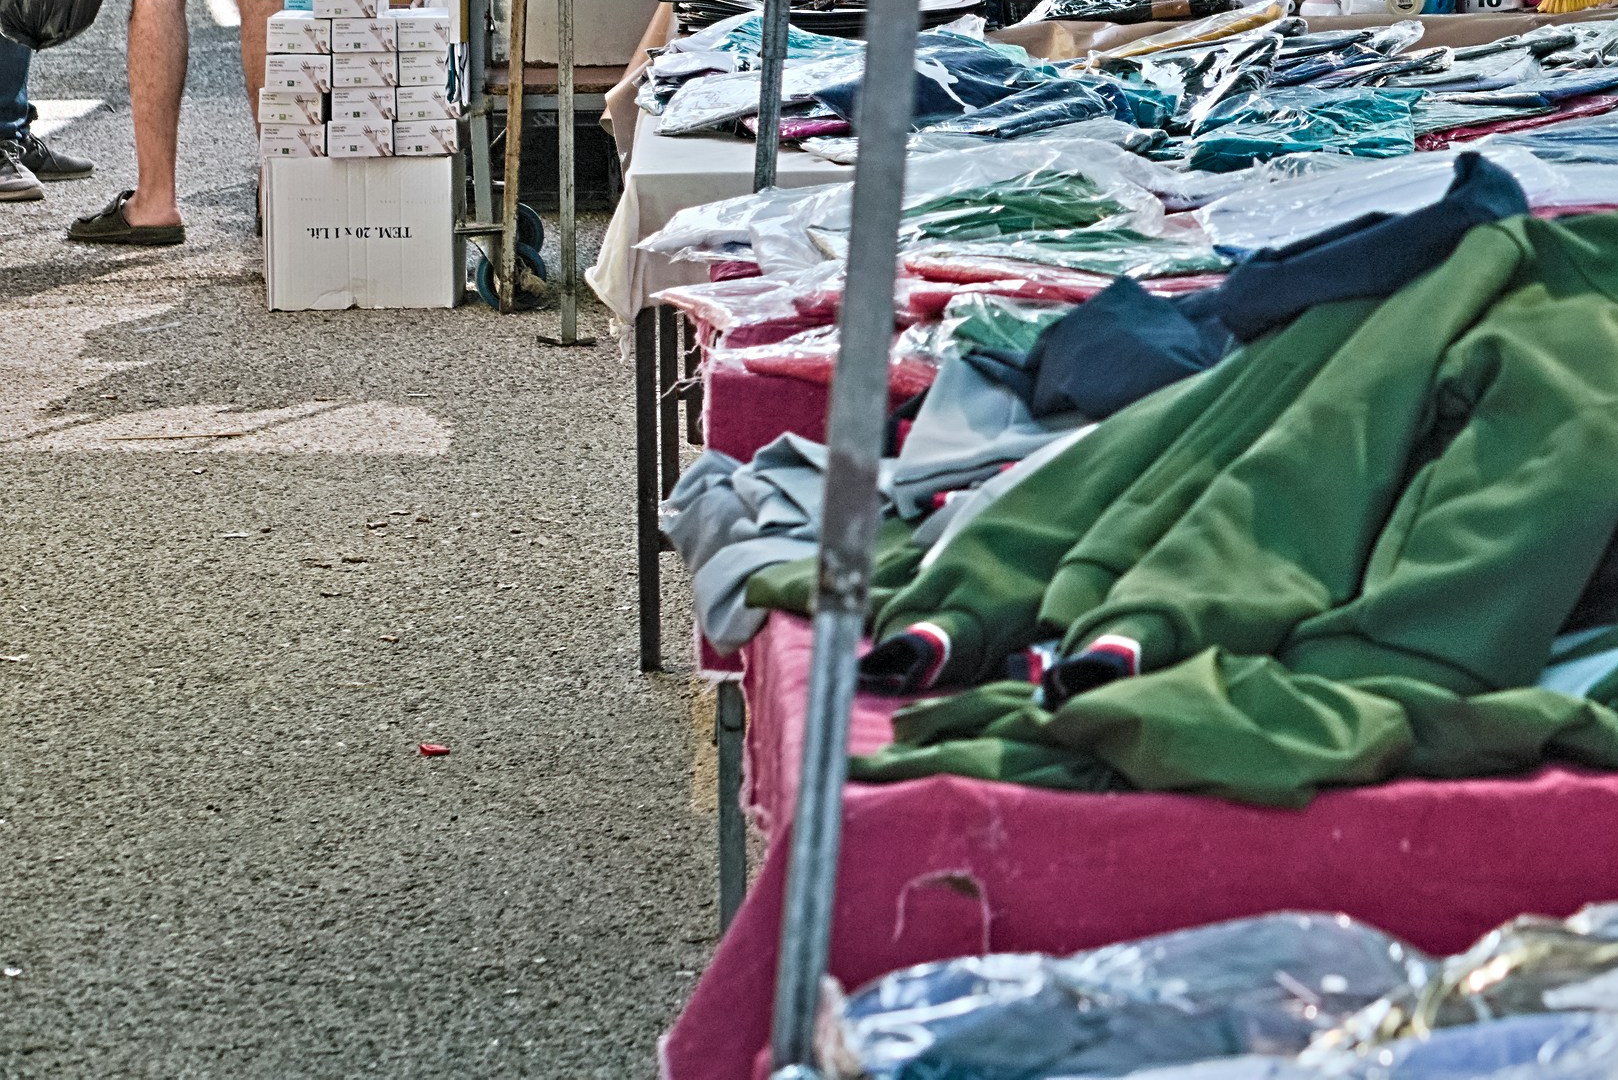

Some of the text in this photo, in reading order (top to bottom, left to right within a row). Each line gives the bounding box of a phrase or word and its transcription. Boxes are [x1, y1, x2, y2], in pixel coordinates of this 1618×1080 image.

[306, 227, 329, 239] Lit.
[334, 227, 340, 239] 1
[355, 227, 371, 239] 20
[374, 227, 412, 239] TEM.
